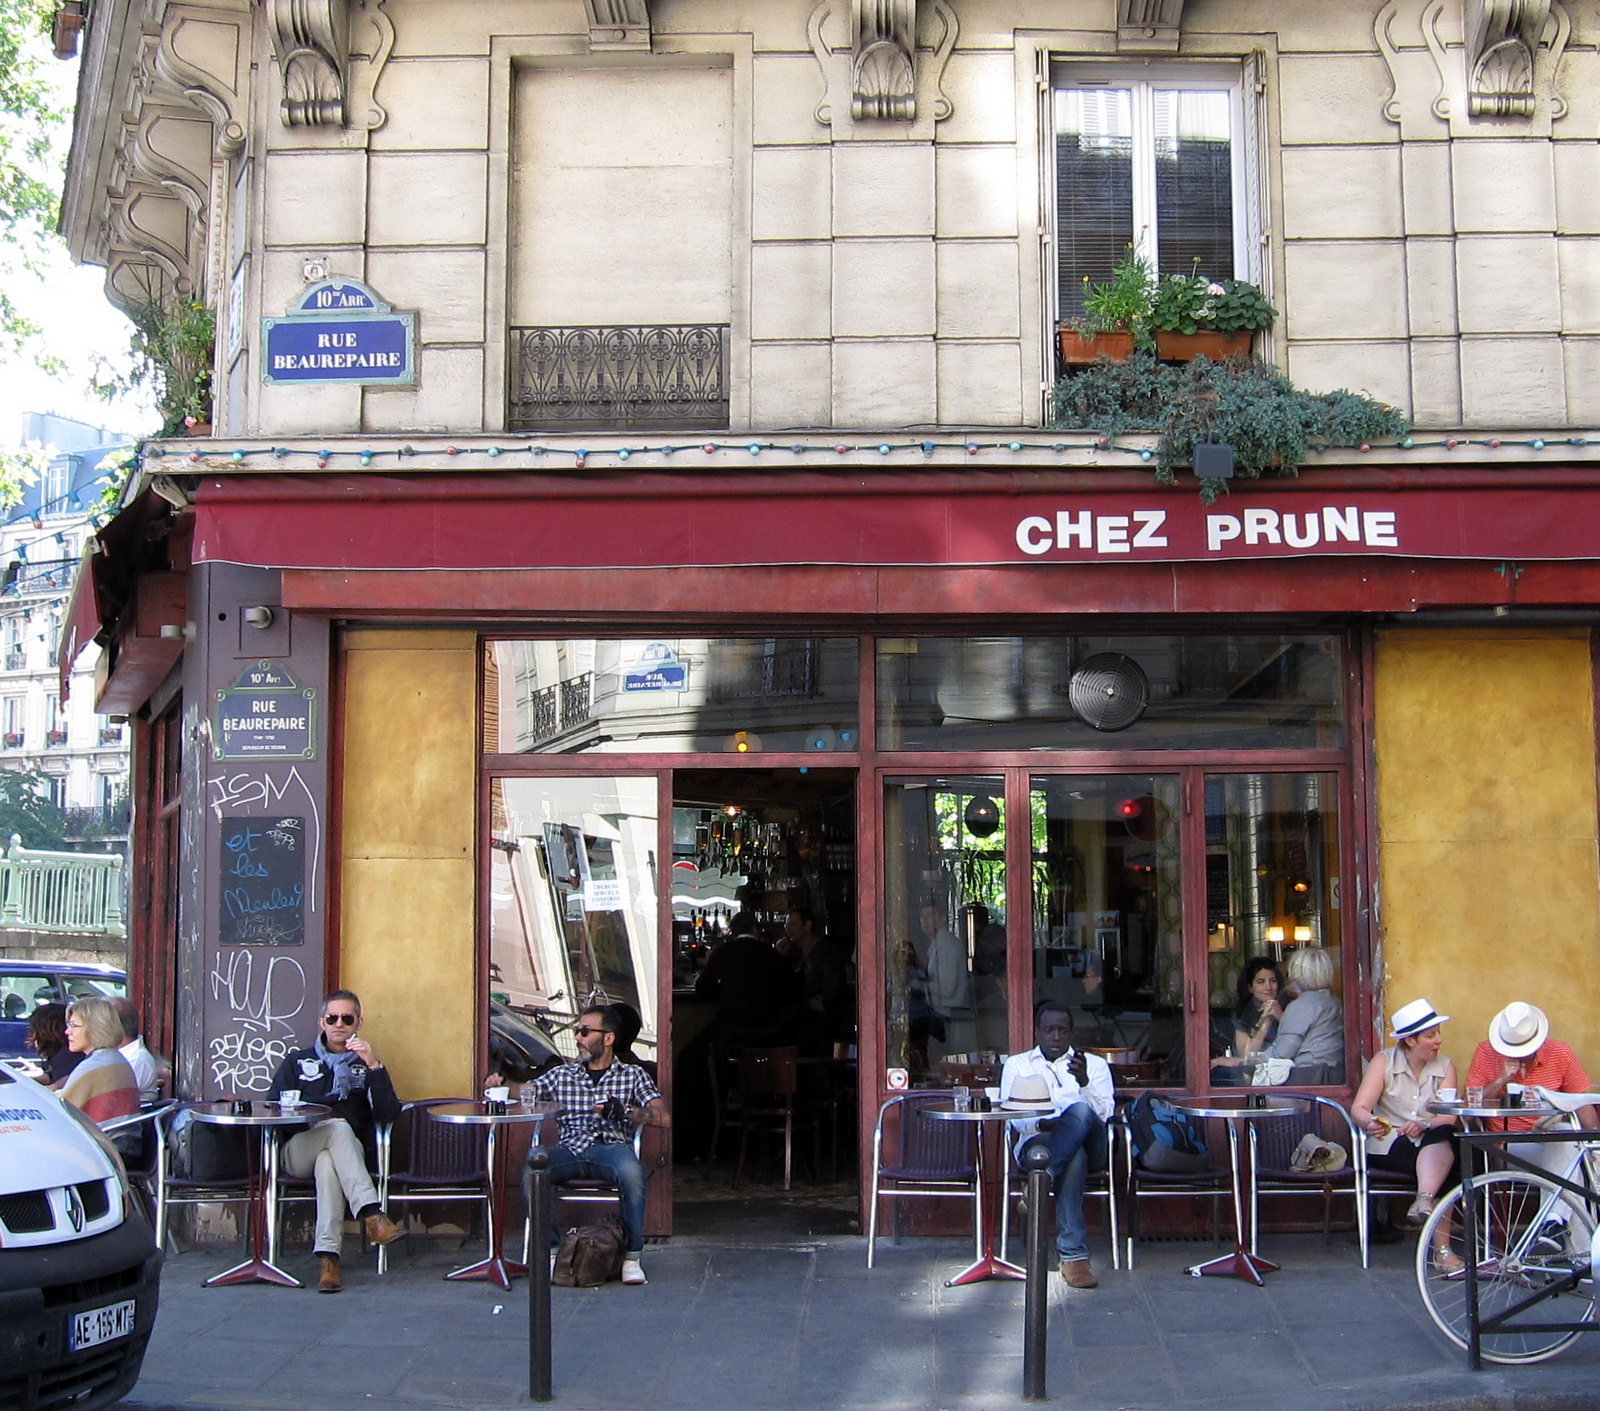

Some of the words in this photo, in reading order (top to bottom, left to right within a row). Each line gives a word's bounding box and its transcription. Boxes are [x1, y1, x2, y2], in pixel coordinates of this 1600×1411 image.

[318, 333, 358, 348] RUE
[273, 352, 401, 370] BEAUREPAIRE
[1015, 509, 1168, 556] CHEZ
[1206, 506, 1399, 551] PRUNE
[252, 700, 277, 713] RUE
[223, 717, 306, 731] BEAUREPAIRE
